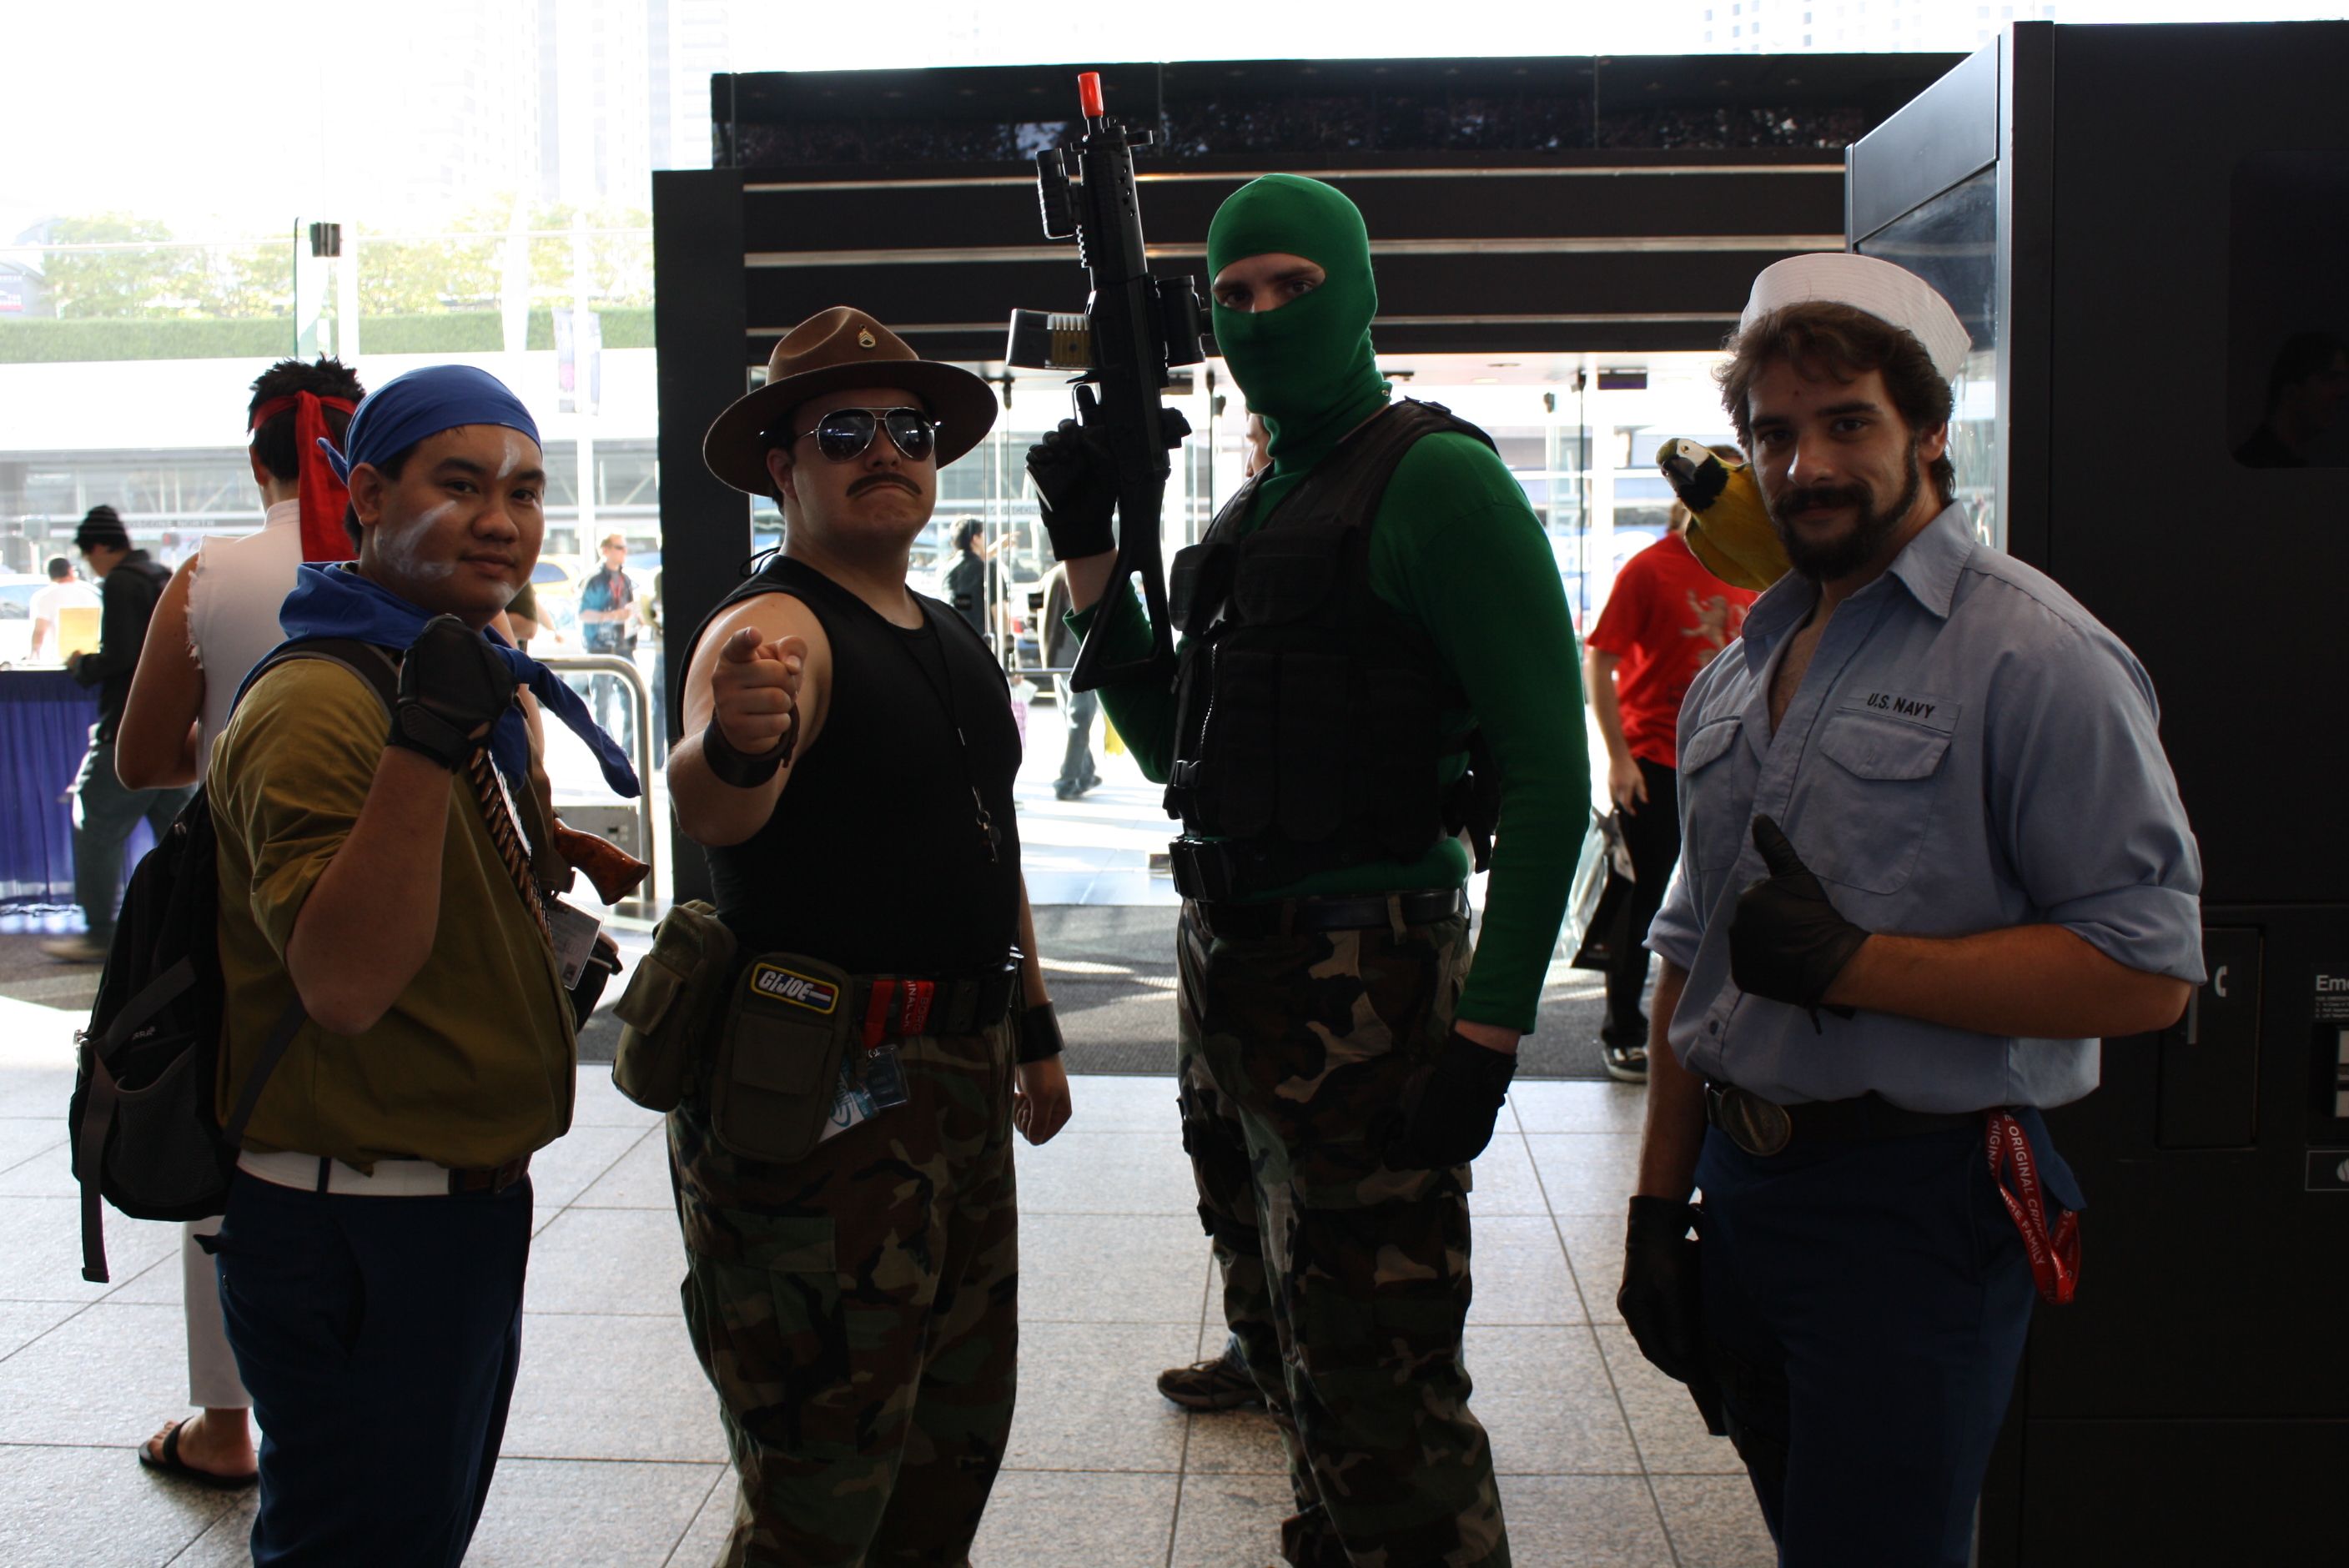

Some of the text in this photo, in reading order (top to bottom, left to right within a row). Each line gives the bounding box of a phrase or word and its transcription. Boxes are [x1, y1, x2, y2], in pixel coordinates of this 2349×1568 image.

[1867, 693, 1935, 718] U.S. NAVY
[2009, 1125, 2035, 1195] ORIGINAL
[2021, 1219, 2046, 1265] FAMILY
